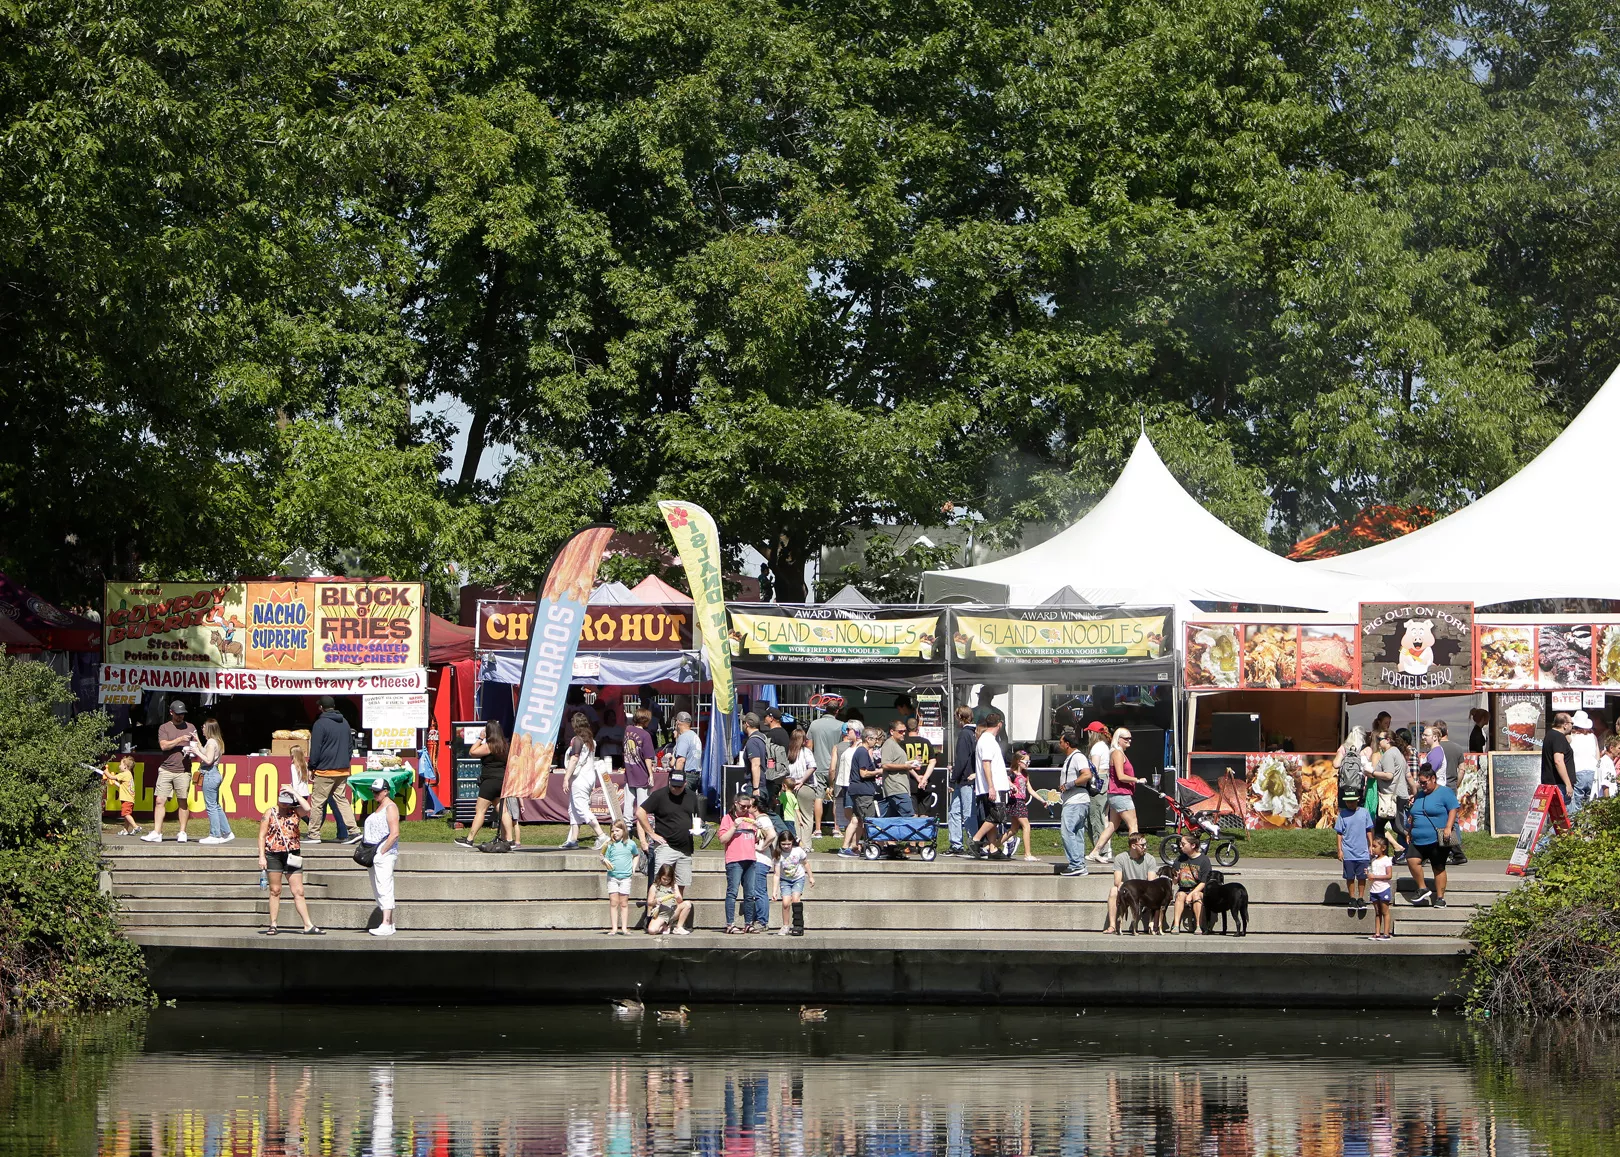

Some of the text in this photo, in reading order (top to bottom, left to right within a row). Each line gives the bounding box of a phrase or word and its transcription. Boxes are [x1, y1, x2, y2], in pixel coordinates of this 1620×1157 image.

[130, 588, 145, 596] TRY
[320, 587, 411, 606] BLOCK
[110, 585, 231, 627] COWBOY
[252, 603, 306, 625] NACHO
[794, 608, 876, 620] AWARD WINNING
[1020, 610, 1103, 620] AWARD WINNING
[107, 605, 224, 645] BURRITO
[320, 617, 412, 639] FRIES
[486, 613, 687, 642] CHRO HUT
[1362, 606, 1470, 635] PIG OUT ON PORK
[252, 629, 308, 650] SUPREME
[752, 621, 917, 645] ISLAND NOODLES
[979, 623, 1144, 645] ISLAND NOODLES
[147, 637, 189, 650] Steak
[124, 651, 210, 662] Potato & Cheese
[128, 668, 257, 690] CANADIAN FRIES
[520, 605, 575, 734] CHURROS
[1430, 667, 1452, 687] BBQ
[100, 684, 141, 693] PICK UP
[265, 673, 421, 690] (Brown Gravy & Cheese)
[103, 695, 136, 704] HERE
[373, 728, 416, 738] ORDER
[378, 738, 411, 748] HERE
[1501, 727, 1522, 741] Cowboy
[905, 743, 930, 765] DEA
